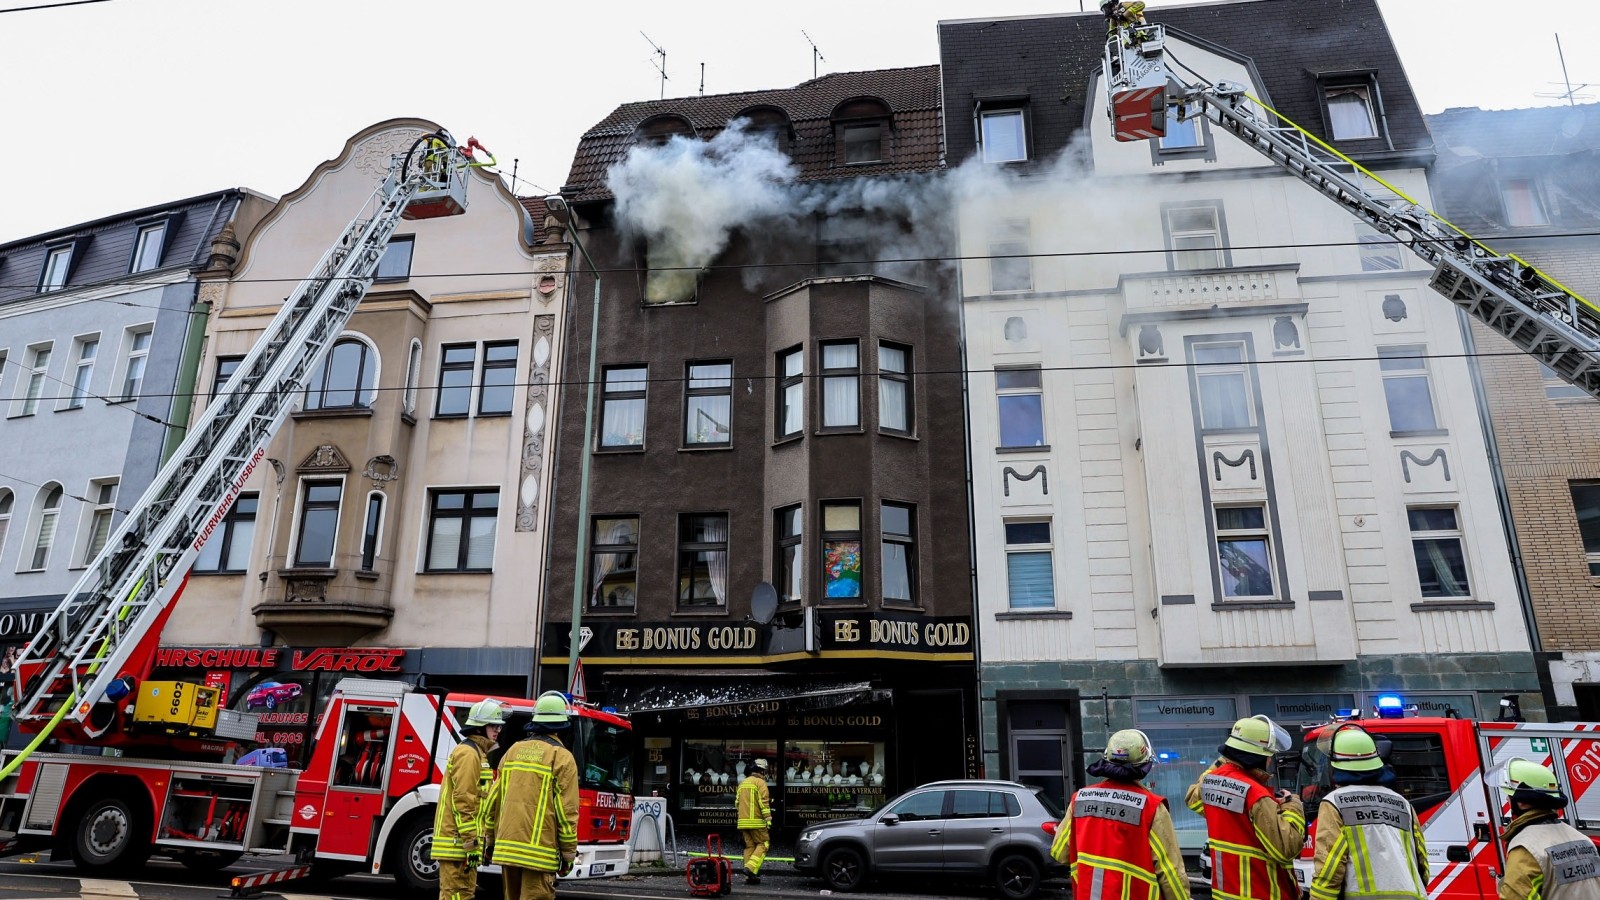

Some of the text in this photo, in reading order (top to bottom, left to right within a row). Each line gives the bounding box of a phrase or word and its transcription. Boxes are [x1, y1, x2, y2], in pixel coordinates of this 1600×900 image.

[1136, 58, 1160, 81] MAGIRUS
[193, 447, 265, 552] FEUERWEHR DUISBURG
[642, 627, 700, 649] BONUS
[707, 627, 756, 649] GOLD
[870, 619, 919, 645] BONUS
[924, 623, 969, 646] GOLD
[291, 648, 403, 672] VAROL
[170, 682, 183, 715] 6602
[706, 705, 742, 717] BONUS
[748, 702, 779, 713] GOLD
[1157, 704, 1215, 716] Vermietung
[1277, 703, 1332, 713] Immobilien
[803, 716, 844, 726] BONUS
[847, 715, 881, 726] GOLD
[273, 732, 303, 744] 0203
[856, 787, 883, 795] VERKAUF
[1221, 779, 1246, 794] Duisburg
[1079, 790, 1142, 806] Feuerwehr Duisburg
[1339, 793, 1405, 809] Feuerwehr Duisburg
[1084, 804, 1098, 813] LEH
[1119, 808, 1126, 817] 6
[1355, 809, 1400, 823] BvE-Süd
[1551, 847, 1577, 860] Feuerwehr
